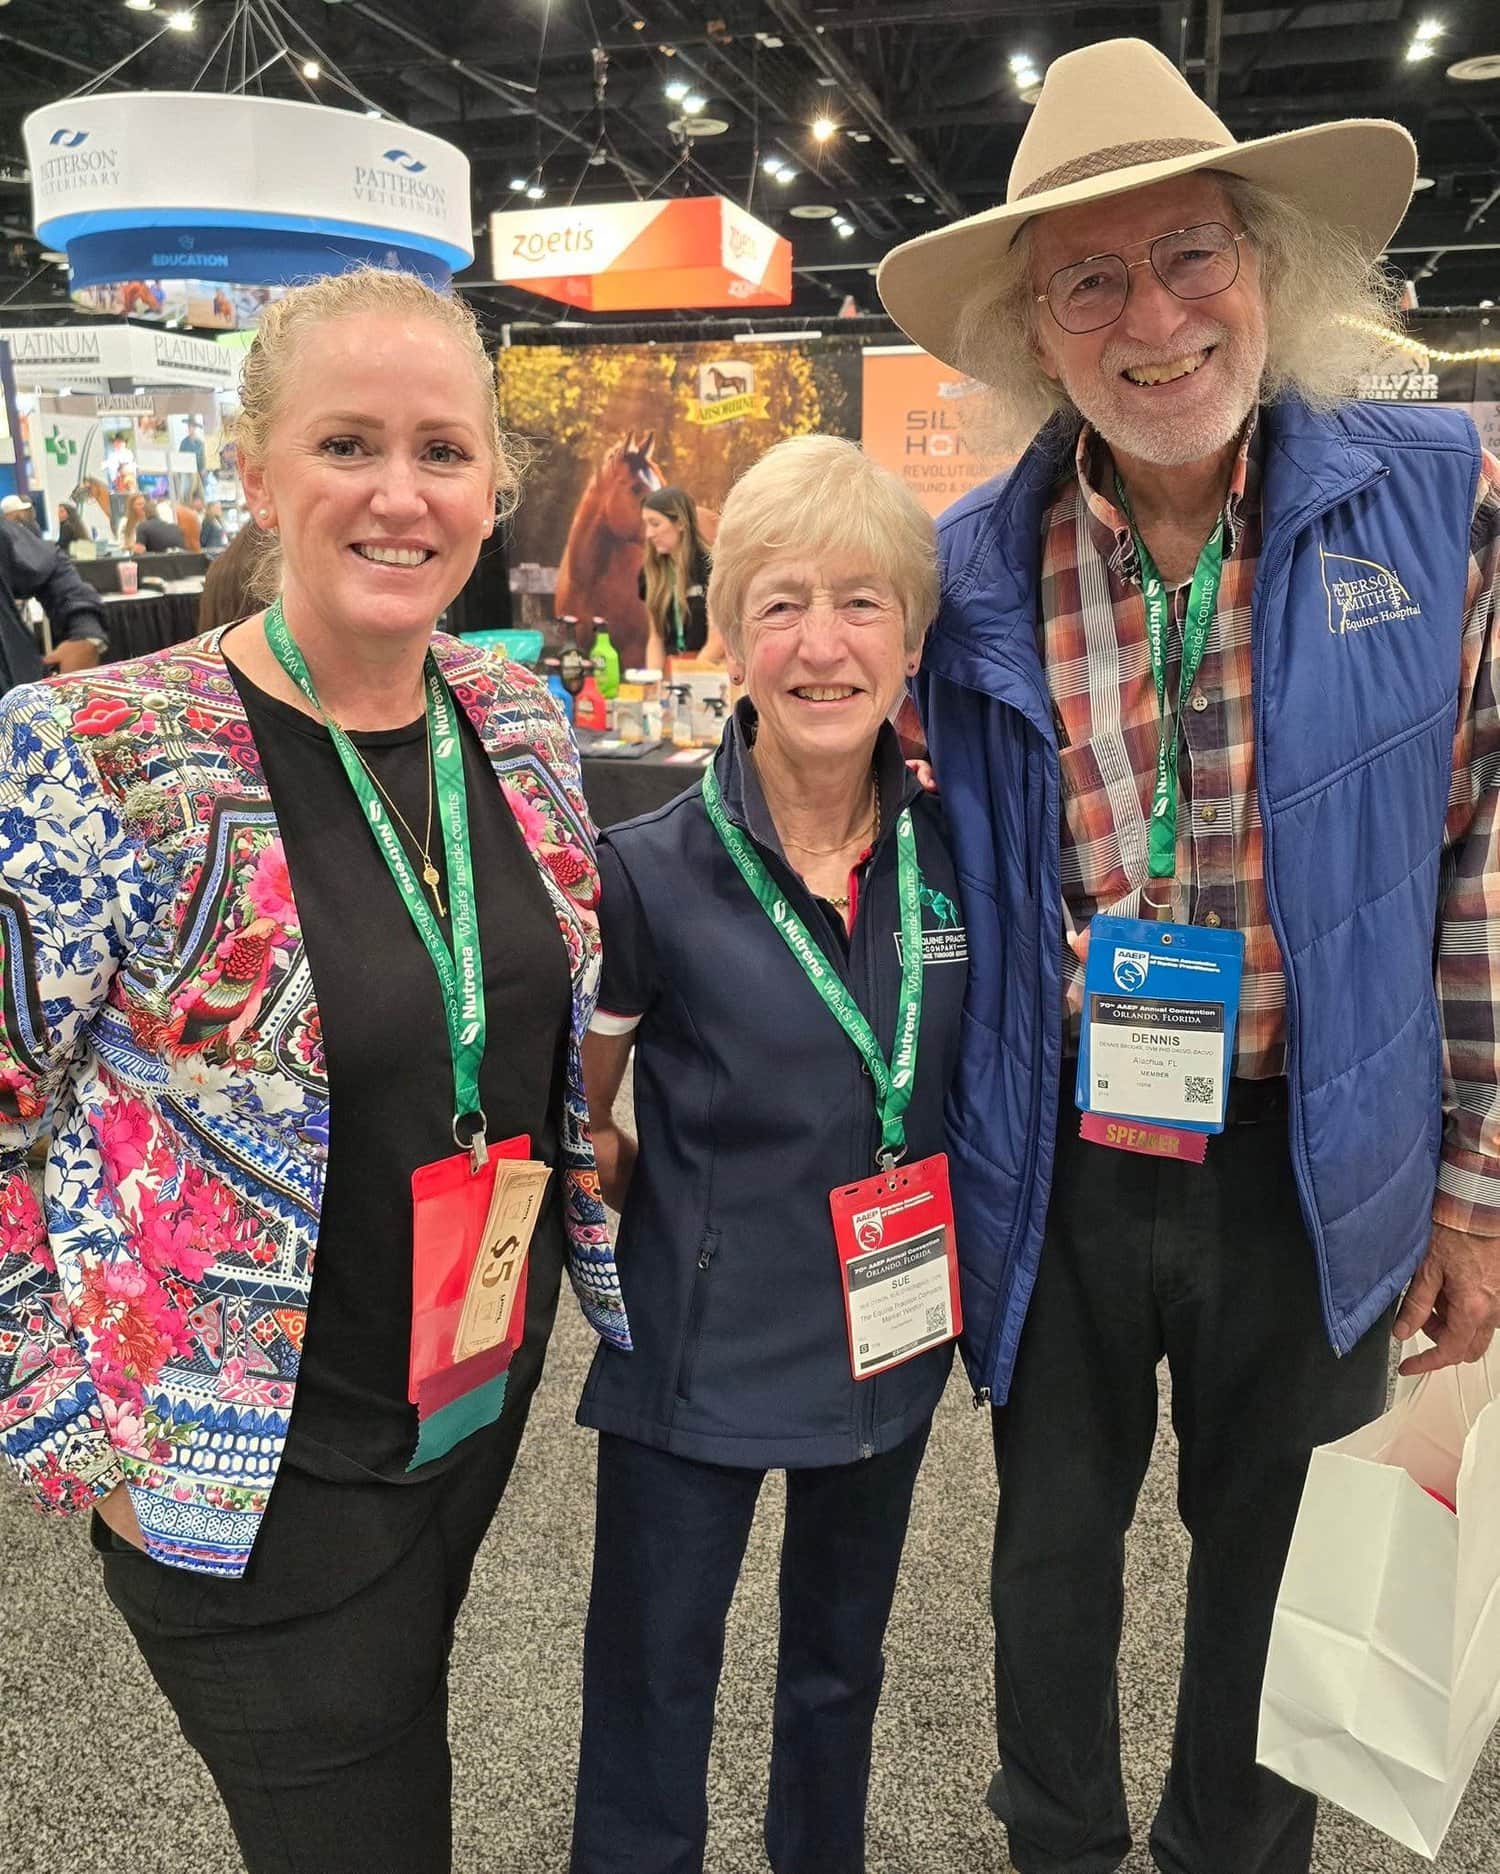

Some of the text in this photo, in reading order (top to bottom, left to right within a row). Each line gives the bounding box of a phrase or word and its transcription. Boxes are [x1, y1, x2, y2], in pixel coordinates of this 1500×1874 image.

[355, 166, 445, 203] PATTERSON
[512, 222, 594, 262] zoetis
[152, 254, 229, 266] EDUCATION
[154, 334, 231, 367] PLATINUM
[1359, 373, 1439, 390] SILVER
[1402, 390, 1438, 399] CARE
[95, 392, 154, 410] PLATINUM
[1380, 603, 1421, 621] Hospital
[1149, 600, 1163, 666] Nutrena
[1189, 628, 1205, 670] inside
[429, 676, 451, 736] Nutrena
[451, 843, 465, 887] inside
[377, 823, 415, 895] Nutrena
[413, 902, 439, 949] What's
[434, 950, 455, 996] inside
[457, 889, 471, 937] What's
[1117, 951, 1147, 960] AAEP
[462, 945, 477, 1019] Nutrena
[782, 921, 824, 979] Nutrena
[823, 980, 852, 1021] What's
[850, 1021, 875, 1059] inside
[896, 1002, 918, 1066] Nutrena
[907, 951, 921, 995] What's
[1162, 1013, 1202, 1024] FLORIDA
[1169, 1008, 1216, 1016] Convention
[1132, 1033, 1181, 1047] DENNIS
[1105, 1124, 1181, 1153] SPEAKER
[481, 1234, 520, 1289] $5
[892, 1274, 911, 1289] SUE
